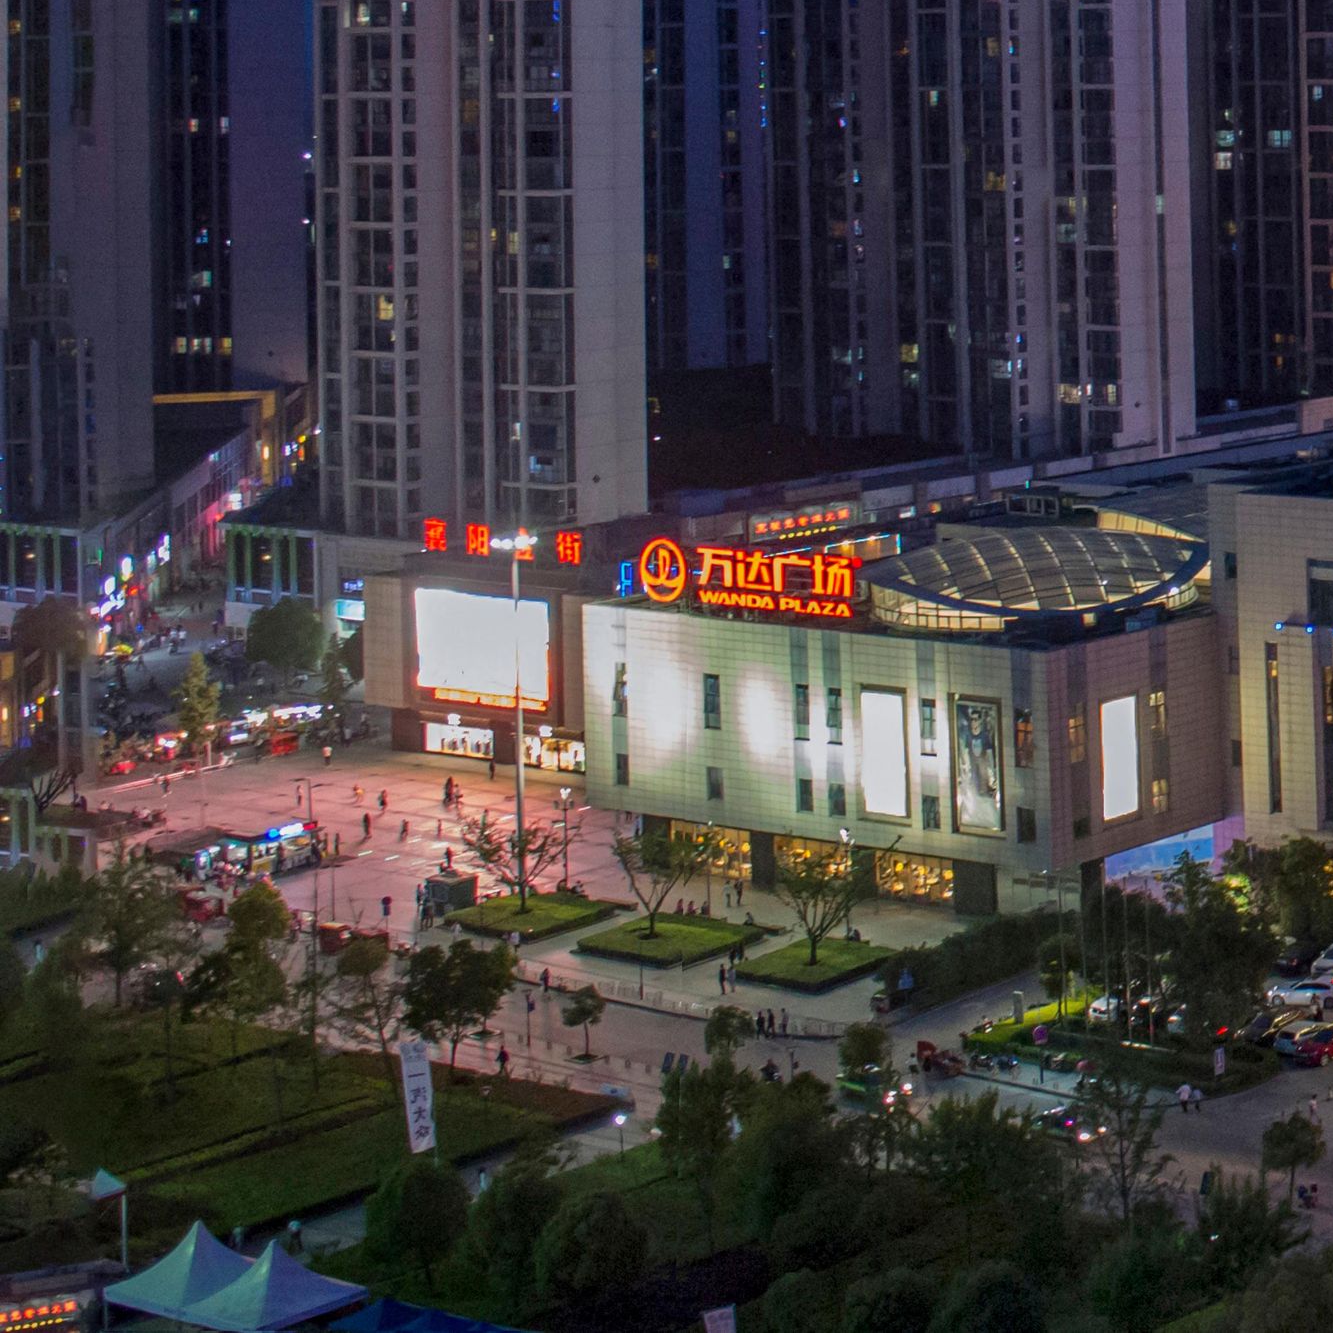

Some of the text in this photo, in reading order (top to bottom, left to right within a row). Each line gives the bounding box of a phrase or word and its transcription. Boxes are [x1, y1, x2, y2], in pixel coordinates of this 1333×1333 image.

[697, 547, 852, 597] 万达广场
[699, 590, 852, 618] WANDA PLAZA
